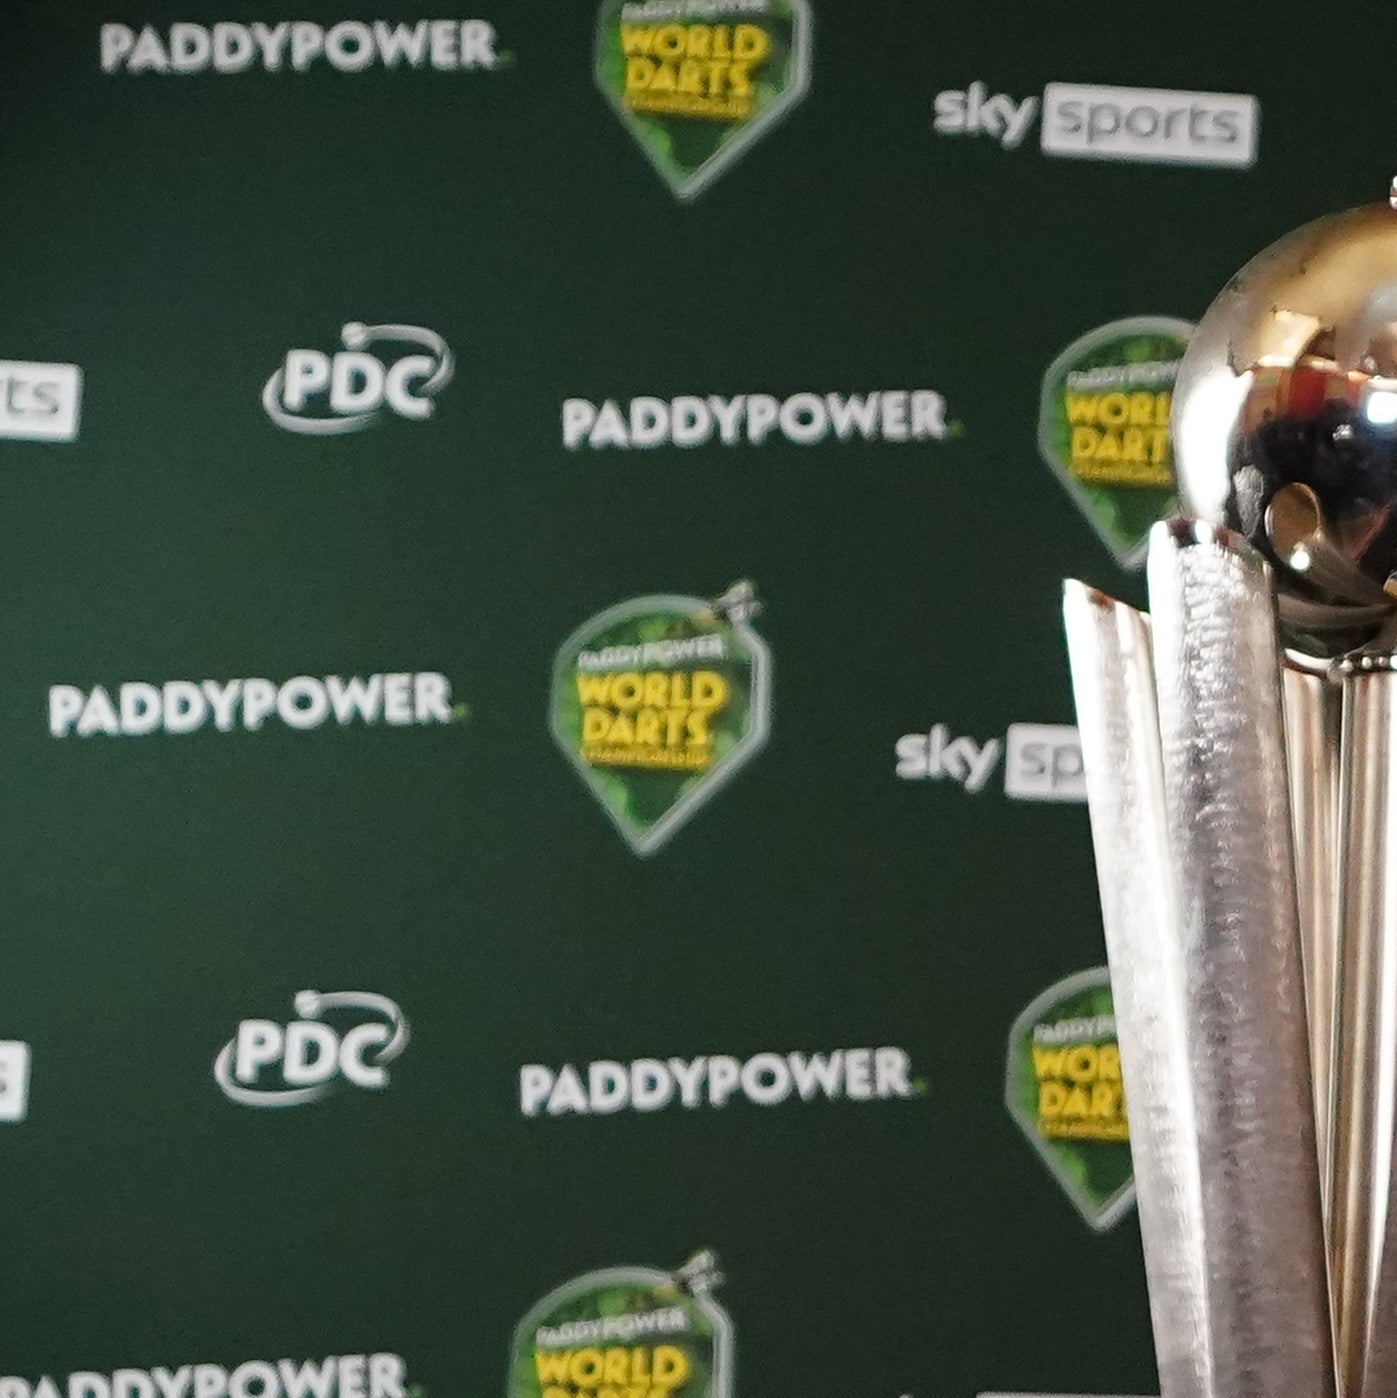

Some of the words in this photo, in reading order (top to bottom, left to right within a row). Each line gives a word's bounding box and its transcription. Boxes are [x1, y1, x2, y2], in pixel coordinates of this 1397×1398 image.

[621, 23, 770, 60] WORLD
[626, 57, 753, 96] DARTS
[934, 81, 1039, 149] sky
[1055, 94, 1242, 149] sports
[284, 348, 436, 420] PDC
[1066, 392, 1172, 427] WORL
[1072, 426, 1171, 464] DART
[577, 670, 731, 711] WORLD
[583, 706, 713, 746] DARTS
[895, 724, 1001, 793] sky
[236, 1019, 390, 1090] PDC
[1032, 1045, 1122, 1083] WOR
[1039, 1080, 1125, 1119] DAR
[536, 1345, 690, 1389] WORLD
